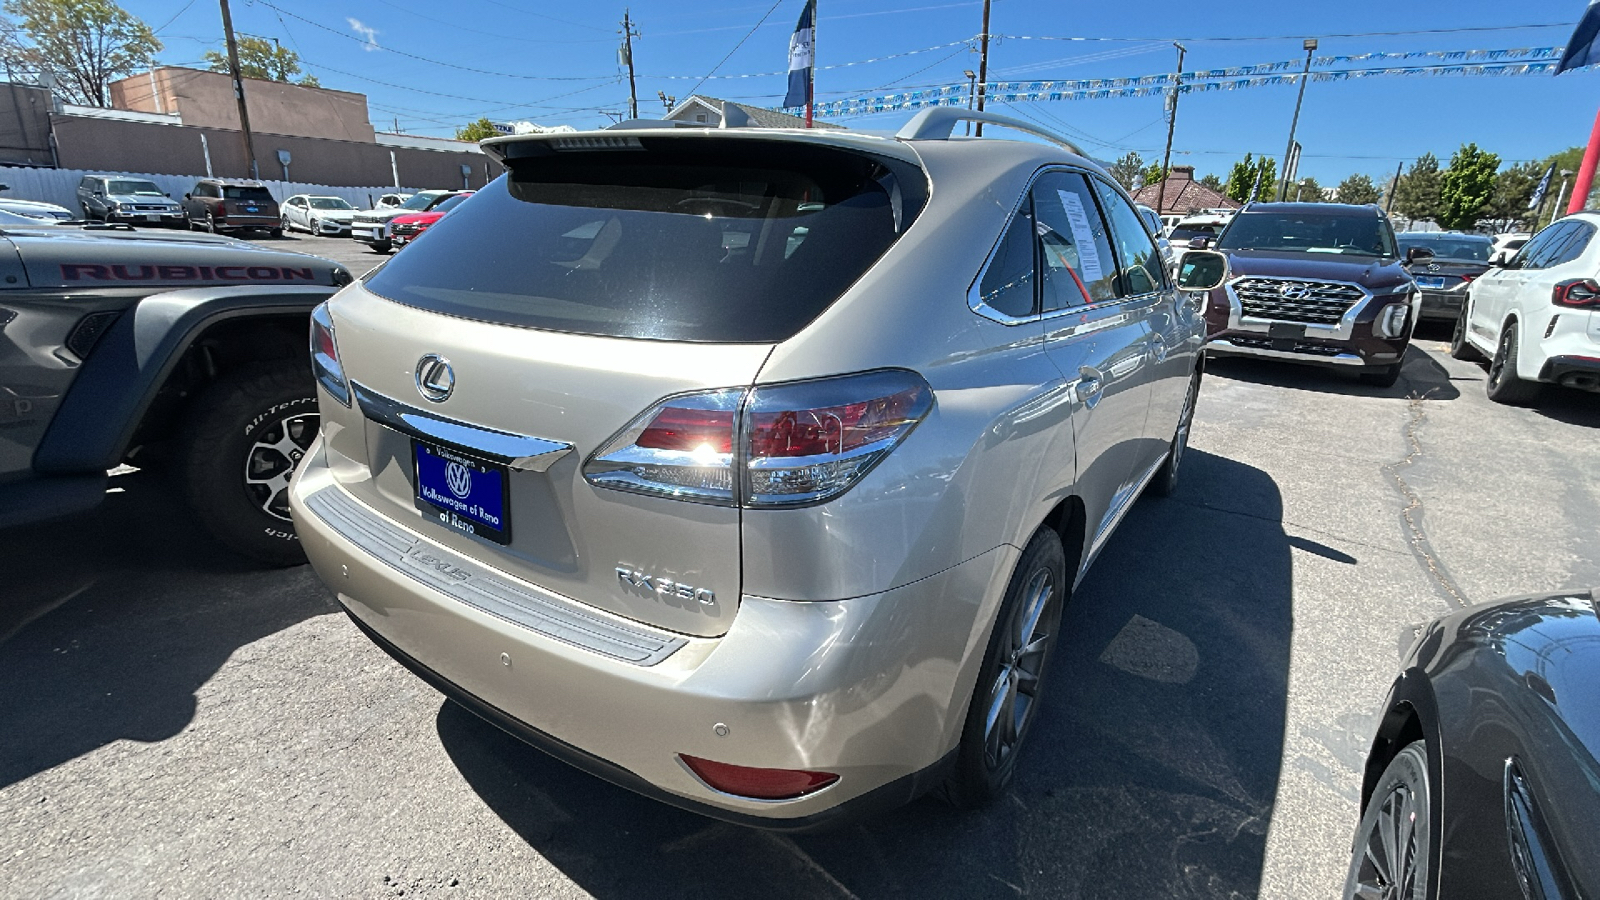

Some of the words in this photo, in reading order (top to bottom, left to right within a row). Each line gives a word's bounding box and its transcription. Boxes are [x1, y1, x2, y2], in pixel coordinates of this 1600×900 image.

[60, 263, 315, 281] RUBICON
[436, 446, 475, 468] Volkswagen
[421, 484, 468, 512] Volkswagen
[469, 504, 478, 516] of
[479, 506, 499, 525] Reno
[440, 510, 449, 523] of
[451, 513, 475, 534] Reno
[410, 551, 472, 581] LEXUS
